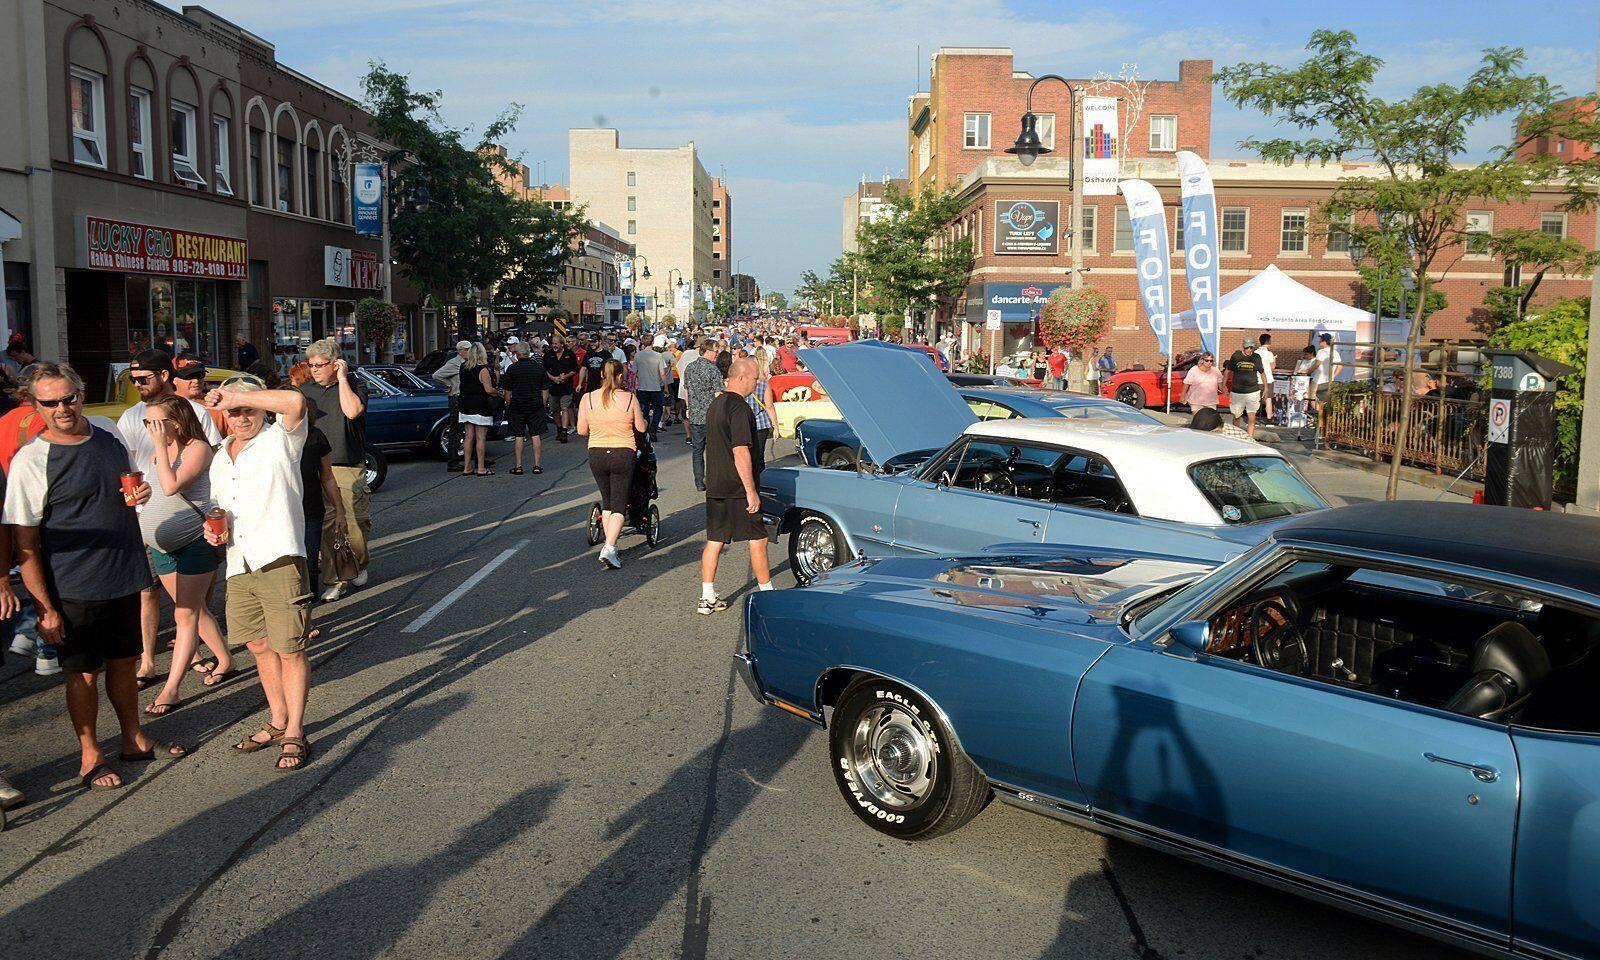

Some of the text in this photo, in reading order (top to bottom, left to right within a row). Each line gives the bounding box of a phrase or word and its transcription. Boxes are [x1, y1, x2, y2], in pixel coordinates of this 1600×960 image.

[1085, 176, 1117, 184] Oshawa
[89, 220, 142, 255] LUCKY
[176, 233, 247, 264] RESTAURANT
[90, 250, 113, 267] Hakka
[116, 252, 144, 270] Chinese
[146, 255, 170, 272] Cuisine
[992, 294, 1030, 304] dancarte
[1493, 366, 1513, 379] 7388
[876, 690, 921, 715] EAGLE
[840, 757, 905, 824] GOODYEAR
[1018, 792, 1034, 802] SS
